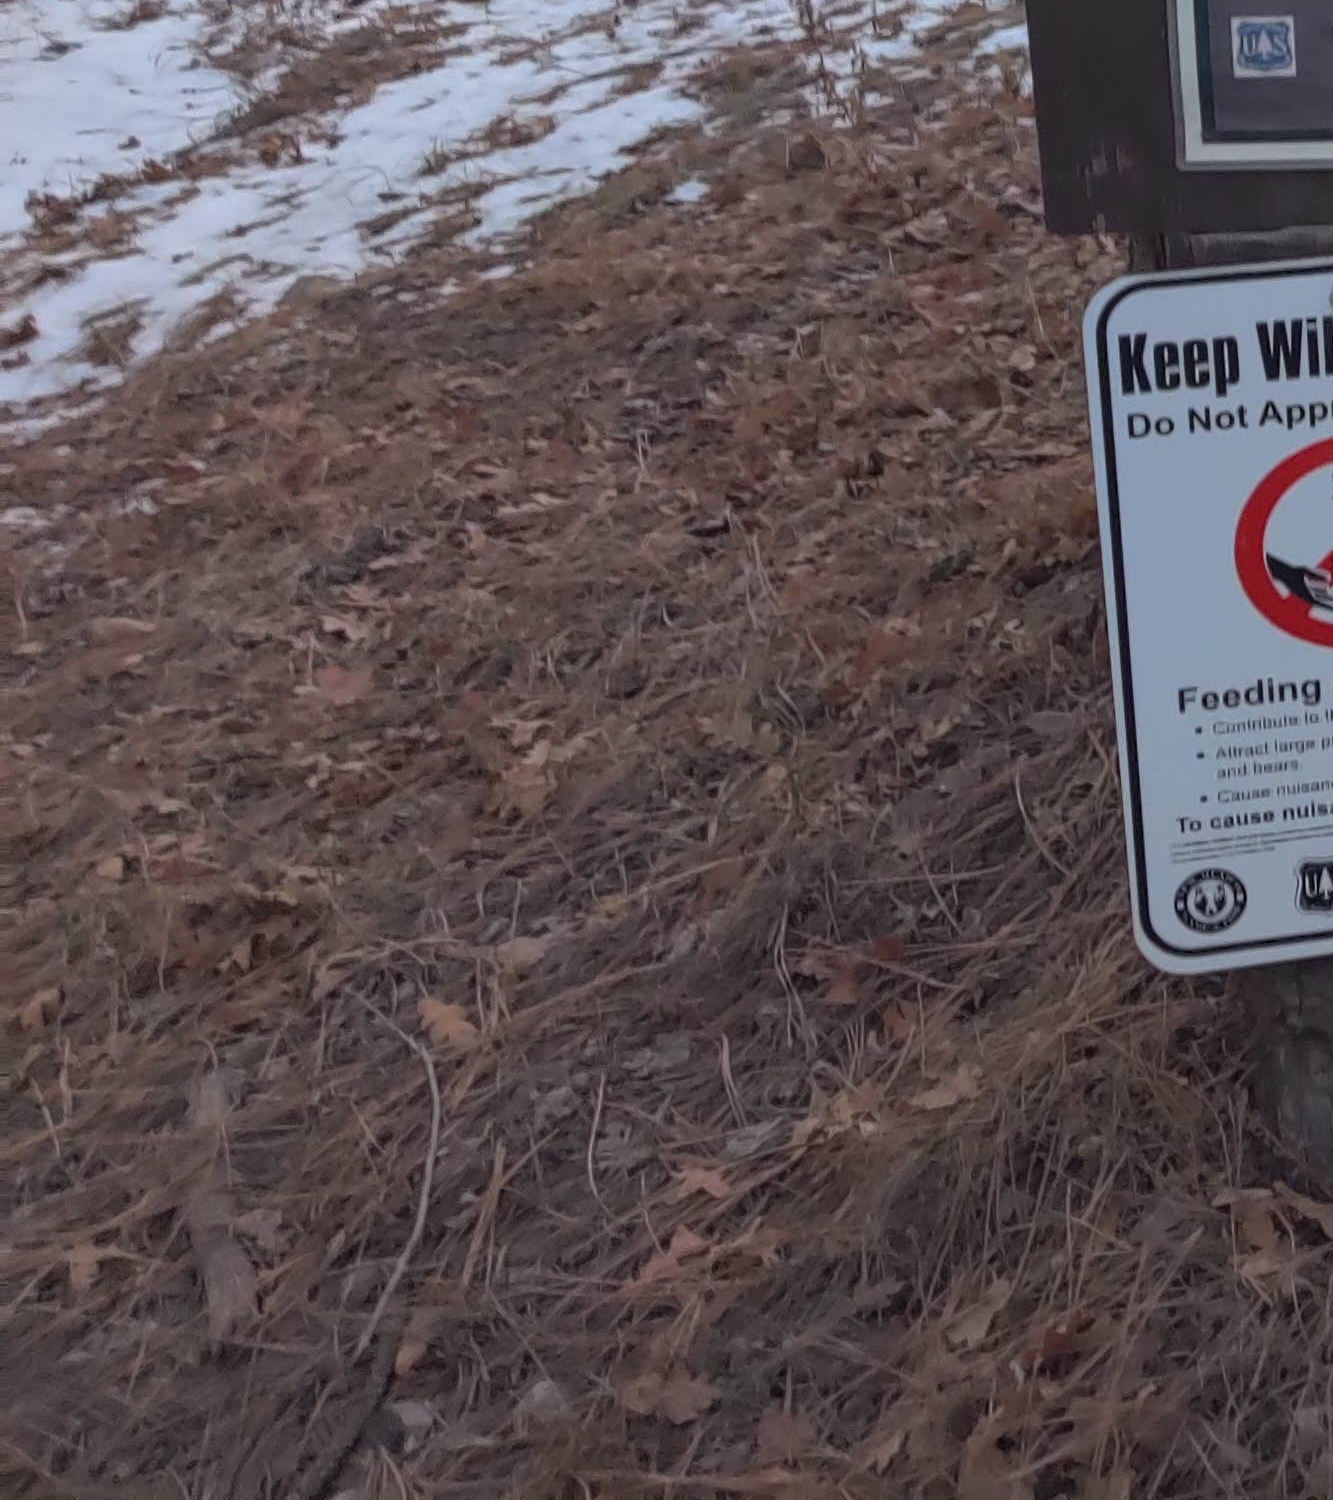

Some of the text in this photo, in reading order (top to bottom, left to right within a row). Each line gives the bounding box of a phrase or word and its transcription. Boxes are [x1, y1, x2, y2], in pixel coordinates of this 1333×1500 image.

[1118, 333, 1241, 397] Keep
[1126, 411, 1175, 439] Do
[1188, 406, 1249, 434] Not
[1177, 676, 1322, 715] Feeding
[1212, 714, 1298, 736] Contribute
[1304, 711, 1320, 725] to
[1215, 742, 1269, 760] Attract
[1274, 738, 1316, 755] large
[1216, 764, 1248, 781] and
[1217, 786, 1272, 804] Cause
[1176, 816, 1202, 834] To
[1209, 809, 1275, 830] cause
